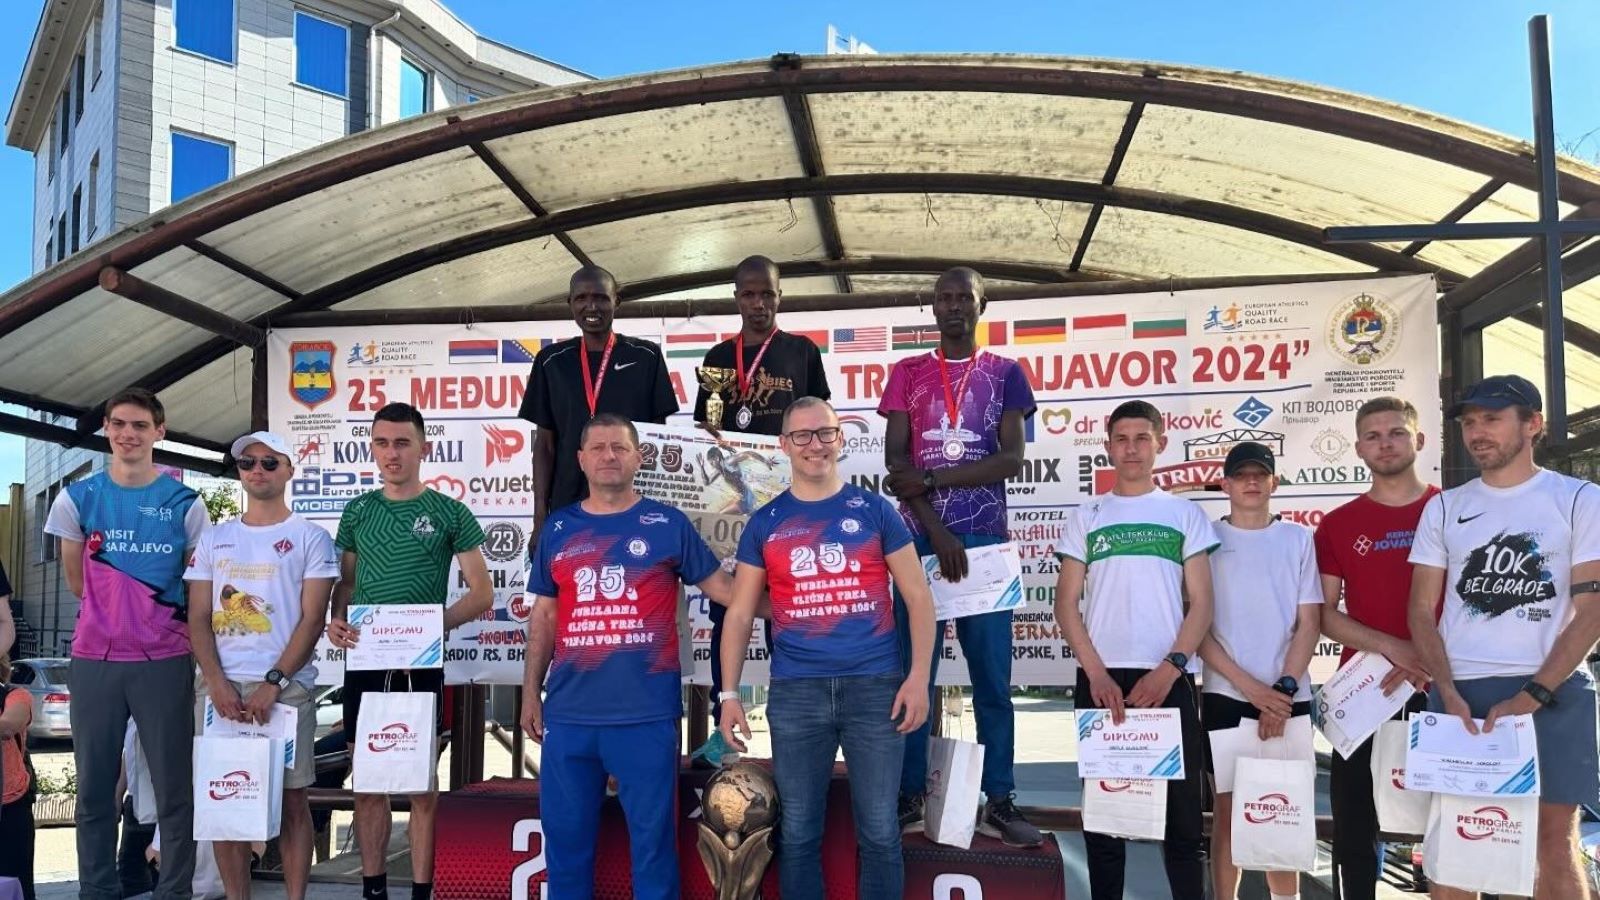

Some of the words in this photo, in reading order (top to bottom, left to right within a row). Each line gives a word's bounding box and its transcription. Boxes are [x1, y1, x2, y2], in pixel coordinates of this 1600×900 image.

[1016, 349, 1178, 392] NJAVOR
[1305, 399, 1365, 415] ВОДОВО
[1074, 415, 1098, 434] dr
[1295, 466, 1351, 483] ATOS
[1014, 511, 1067, 521] MOTEL
[105, 529, 135, 539] VISIT
[491, 530, 515, 552] 23
[105, 542, 173, 554] SARAJEVO
[789, 541, 861, 577] 25.
[1480, 544, 1533, 576] 10K
[573, 562, 638, 602] 25.
[795, 577, 860, 591] JUBILARNA
[1463, 576, 1549, 597] BELGRADE
[837, 590, 868, 601] TRKA
[371, 626, 424, 635] DIPLOMU
[368, 732, 418, 741] PETROGRAF
[1103, 732, 1160, 742] DIPLOMU
[209, 780, 258, 788] PETROGRAF
[1244, 802, 1301, 812] PETROGRAF
[1456, 814, 1523, 829] PETROGRAF
